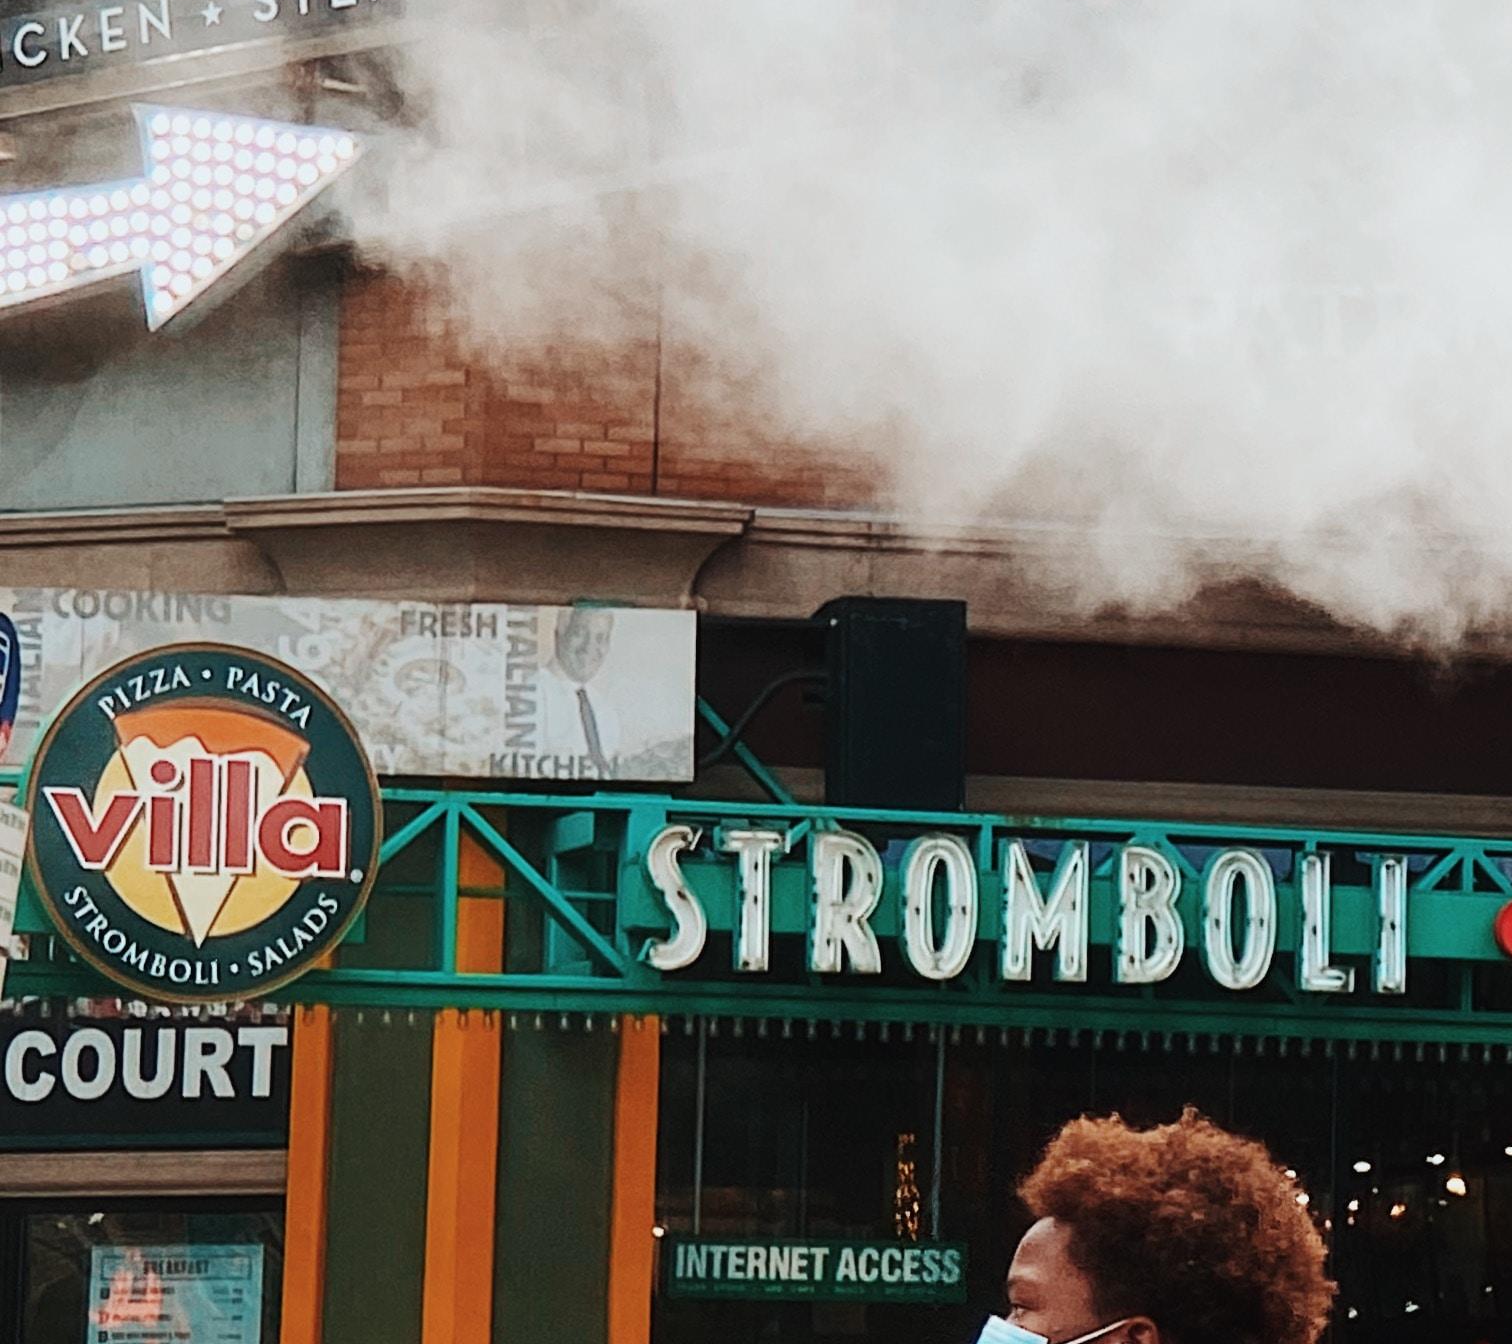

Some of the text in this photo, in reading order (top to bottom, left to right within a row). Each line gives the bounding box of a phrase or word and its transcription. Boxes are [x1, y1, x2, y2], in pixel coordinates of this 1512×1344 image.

[400, 609, 498, 639] FRESH
[98, 664, 312, 729] PIZZA PASTA
[489, 752, 620, 781] KITCHEN
[42, 754, 350, 881] villa
[64, 885, 340, 986] STROMBOLI SALADS
[638, 822, 1409, 994] STROMBOLI
[4, 1027, 288, 1102] COURT
[676, 1242, 962, 1284] INTERNET ACCESS
